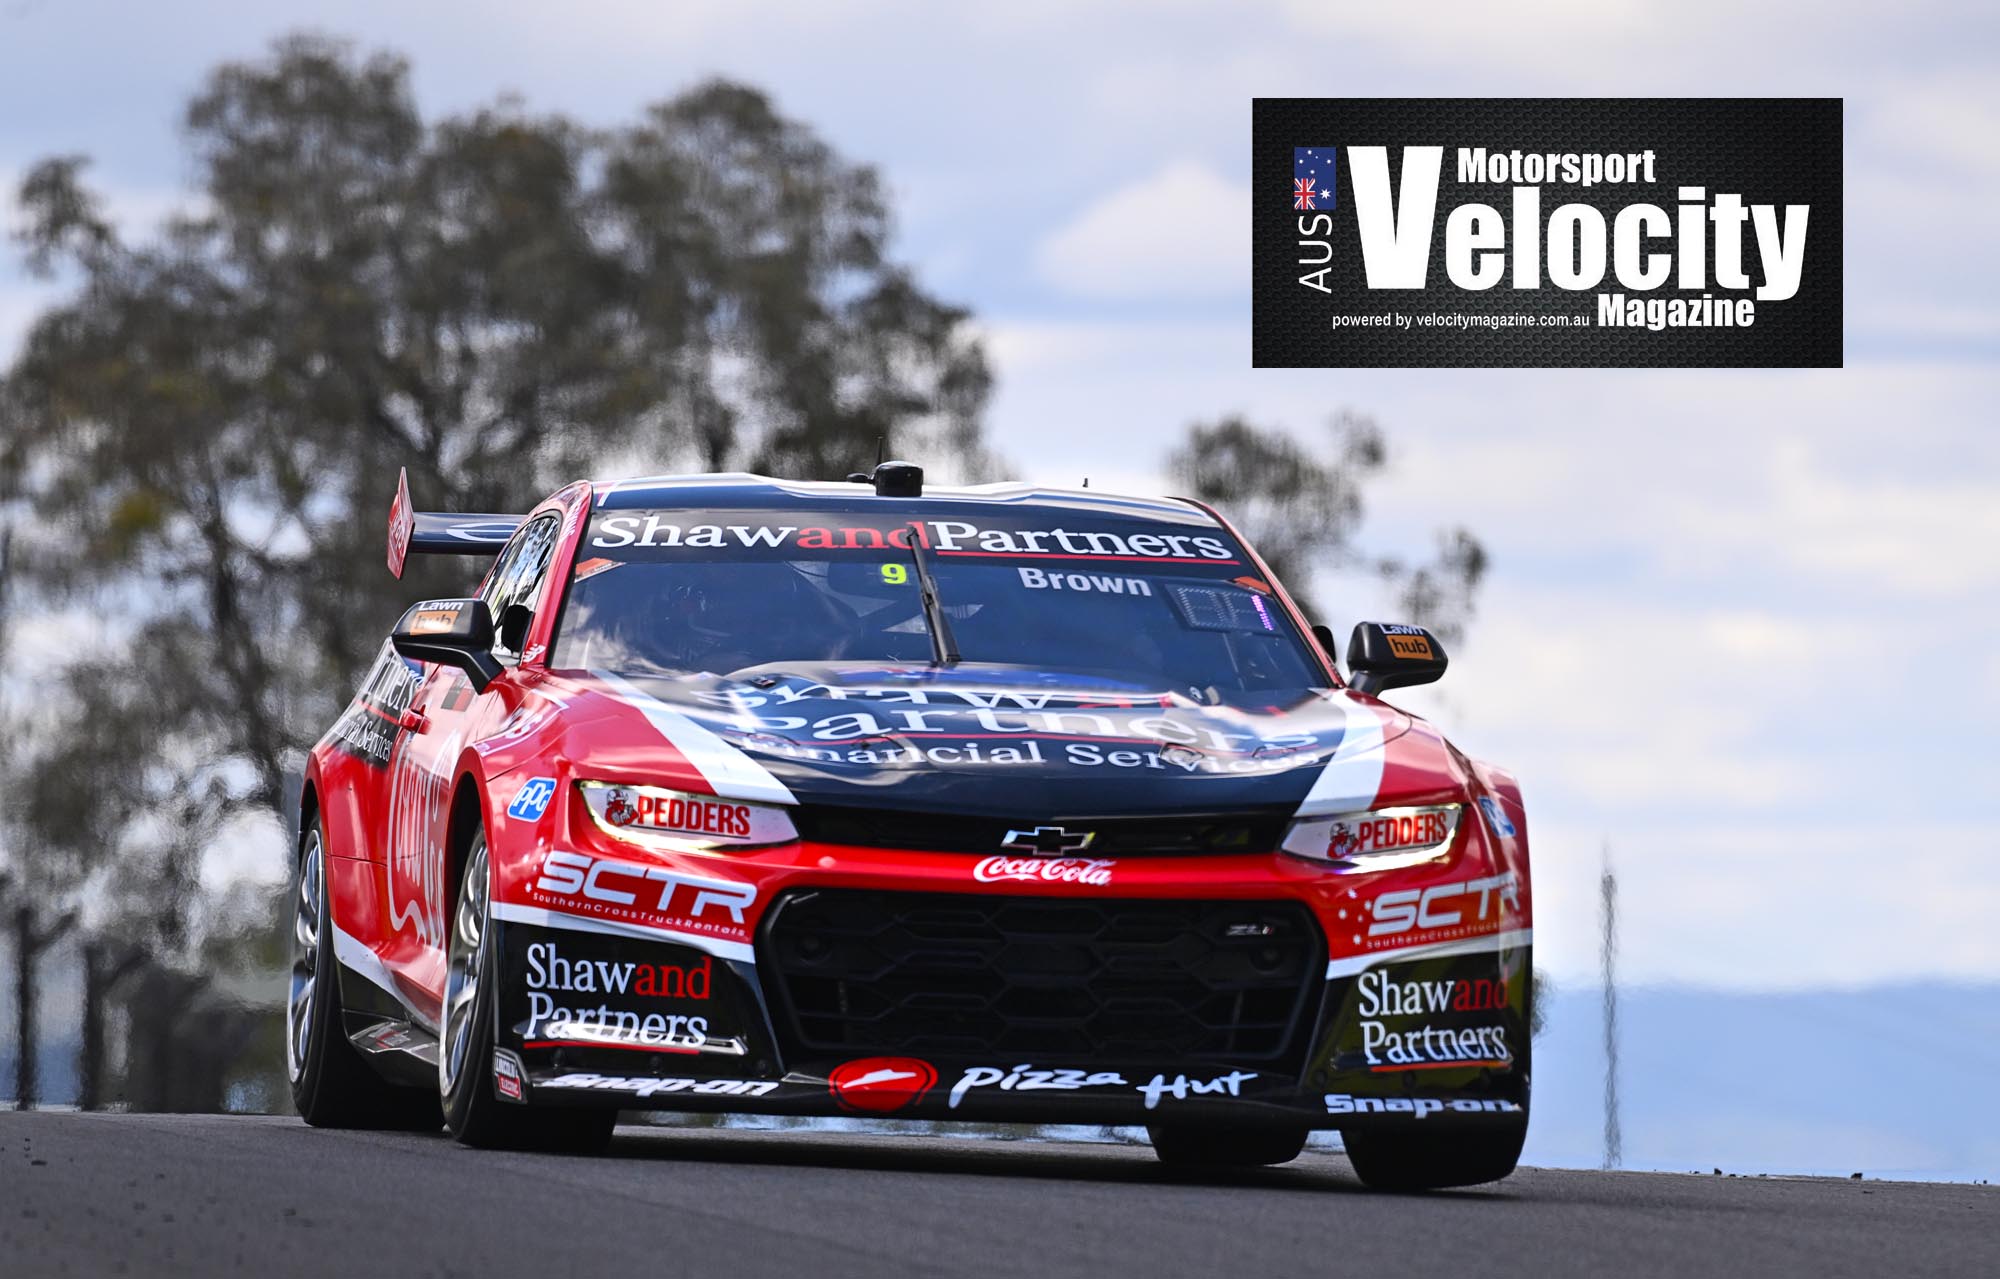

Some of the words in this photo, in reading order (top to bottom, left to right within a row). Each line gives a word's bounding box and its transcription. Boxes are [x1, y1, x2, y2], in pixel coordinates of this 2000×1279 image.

[881, 563, 907, 585] 9
[1018, 567, 1152, 597] Brown
[1391, 638, 1428, 654] hub
[637, 795, 750, 836] PEDDERS
[1359, 812, 1447, 850] PEDDERS
[536, 850, 758, 924] SCTR
[524, 992, 708, 1048] Partners
[1360, 1021, 1509, 1065] Partners
[949, 1064, 1127, 1108] Pizza
[1135, 1071, 1259, 1109] Hut
